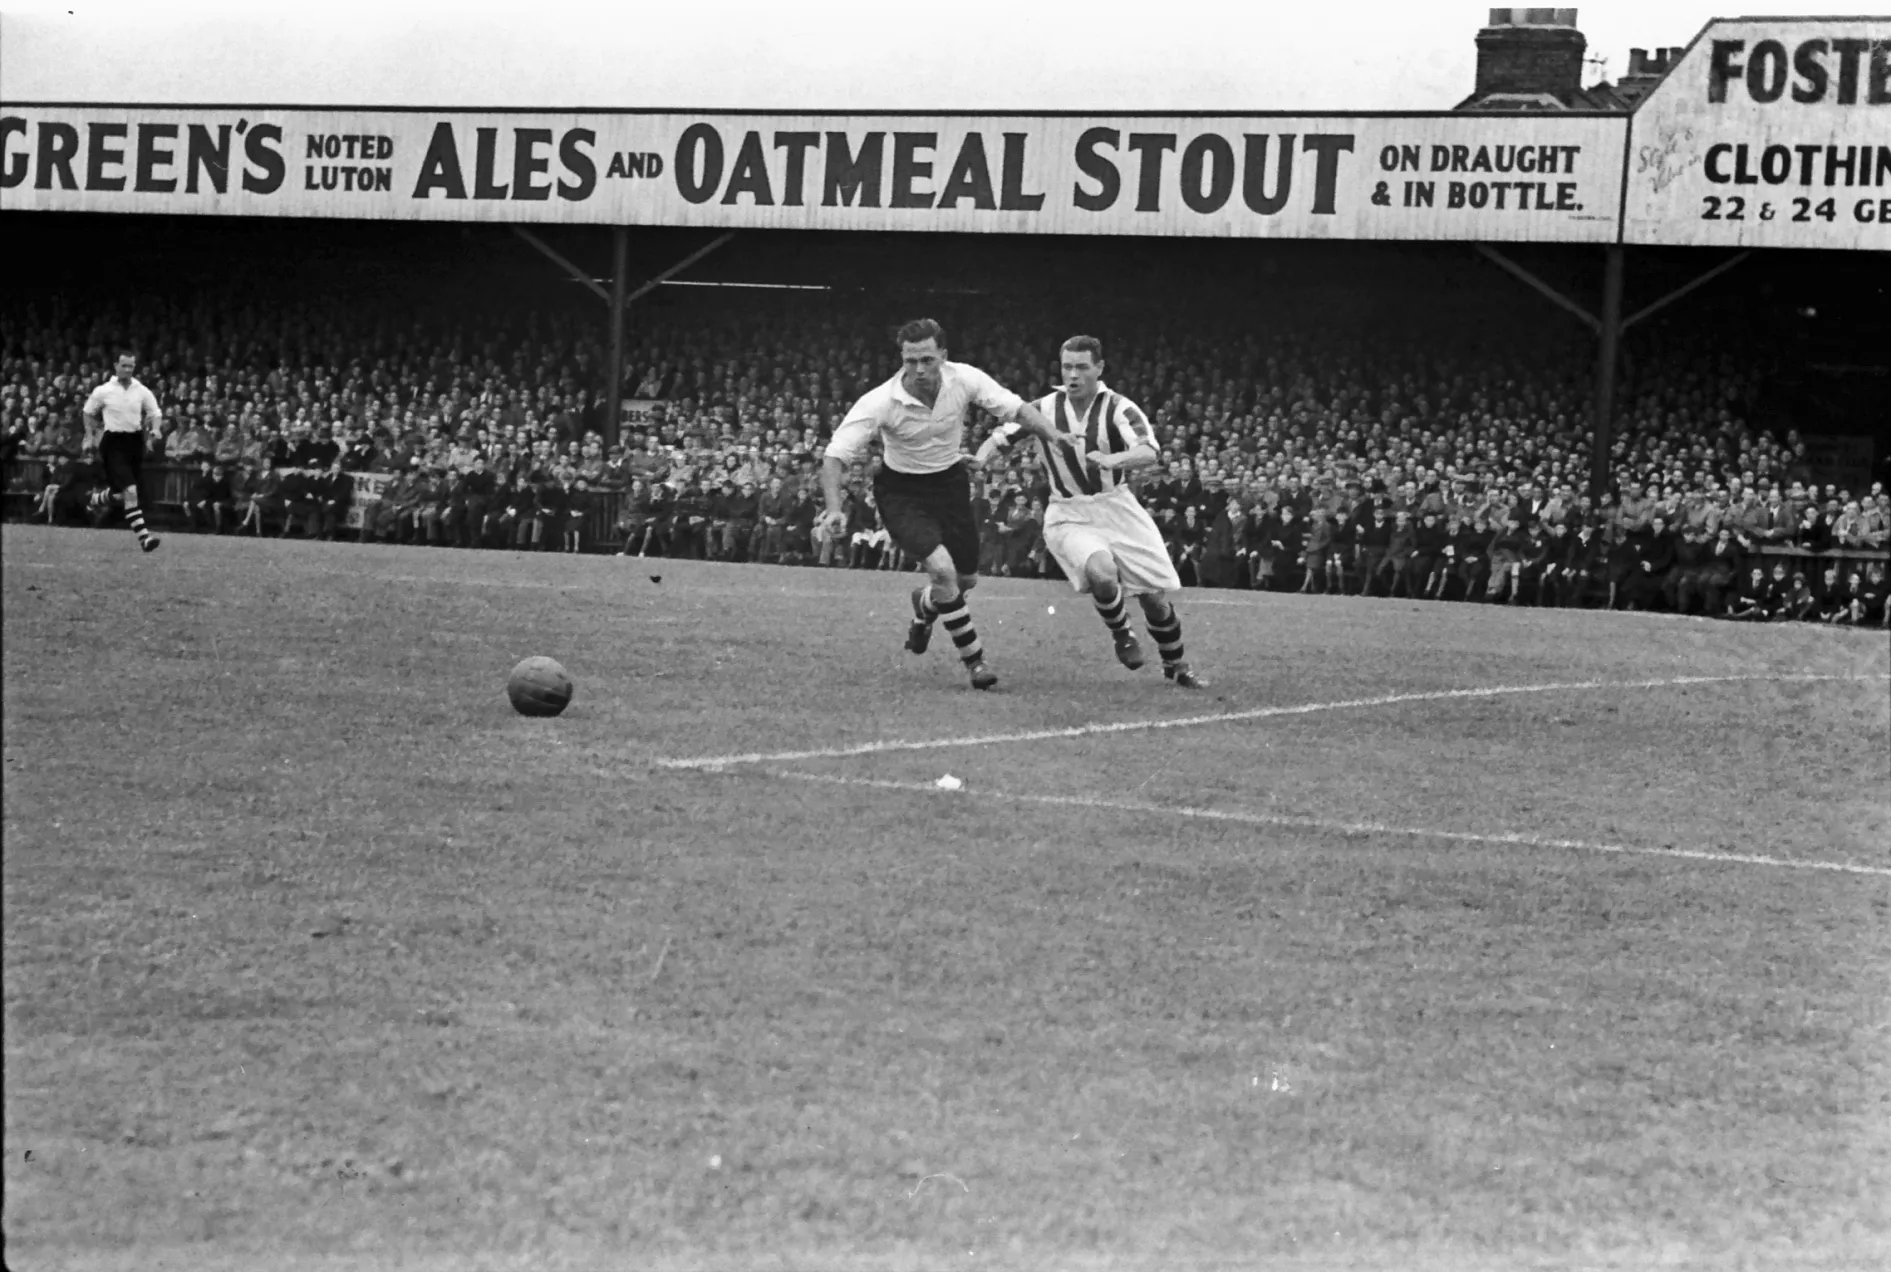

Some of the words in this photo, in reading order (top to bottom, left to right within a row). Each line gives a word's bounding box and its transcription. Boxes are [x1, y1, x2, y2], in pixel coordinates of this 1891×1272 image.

[0, 117, 286, 195] GREEN'S
[306, 134, 394, 160] NOTED
[1379, 144, 1421, 172] ON
[1430, 144, 1581, 174] DRAUGHT
[304, 165, 393, 192] LUTON
[411, 121, 597, 202] ALES
[605, 151, 664, 179] AND
[674, 122, 1046, 212] OATMEAL
[1073, 126, 1355, 216] STOUT
[1370, 180, 1392, 207] &
[1403, 181, 1436, 208] IN
[1447, 181, 1584, 211] BOTTLE.
[1700, 195, 1746, 221] 22
[1758, 202, 1776, 221] &
[1791, 196, 1837, 223] 24
